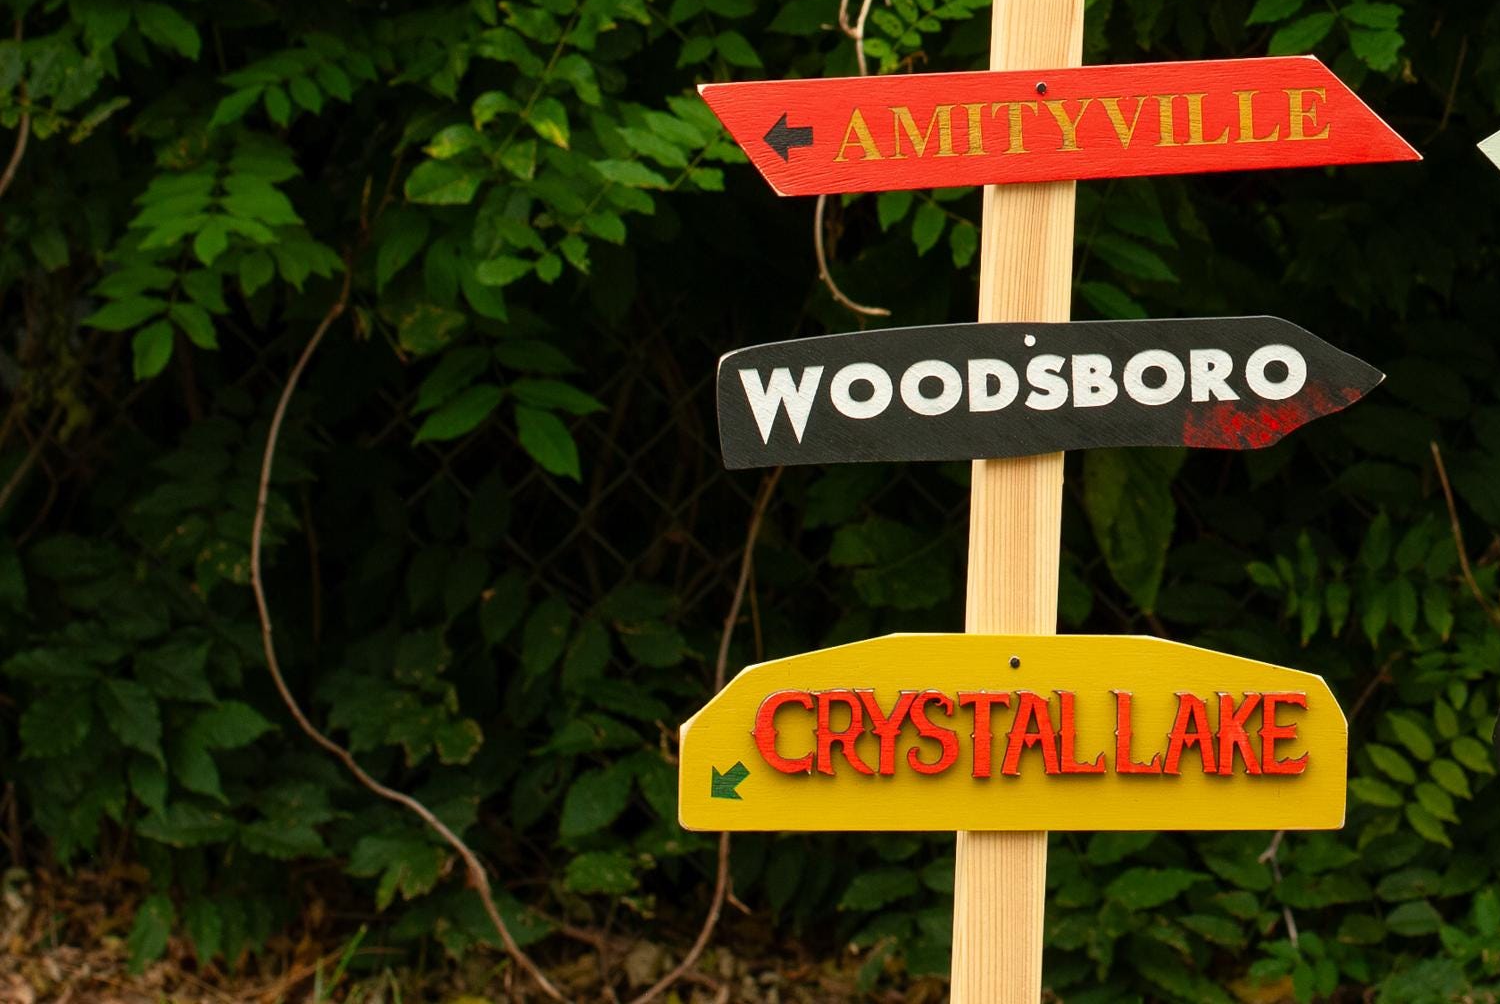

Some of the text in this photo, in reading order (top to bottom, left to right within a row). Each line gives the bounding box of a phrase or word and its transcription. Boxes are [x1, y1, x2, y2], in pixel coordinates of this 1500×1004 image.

[832, 86, 1333, 163] AMITYVILLE
[738, 343, 1308, 446] WOODSBORO
[751, 688, 1312, 779] CRYSTAL LAKE
